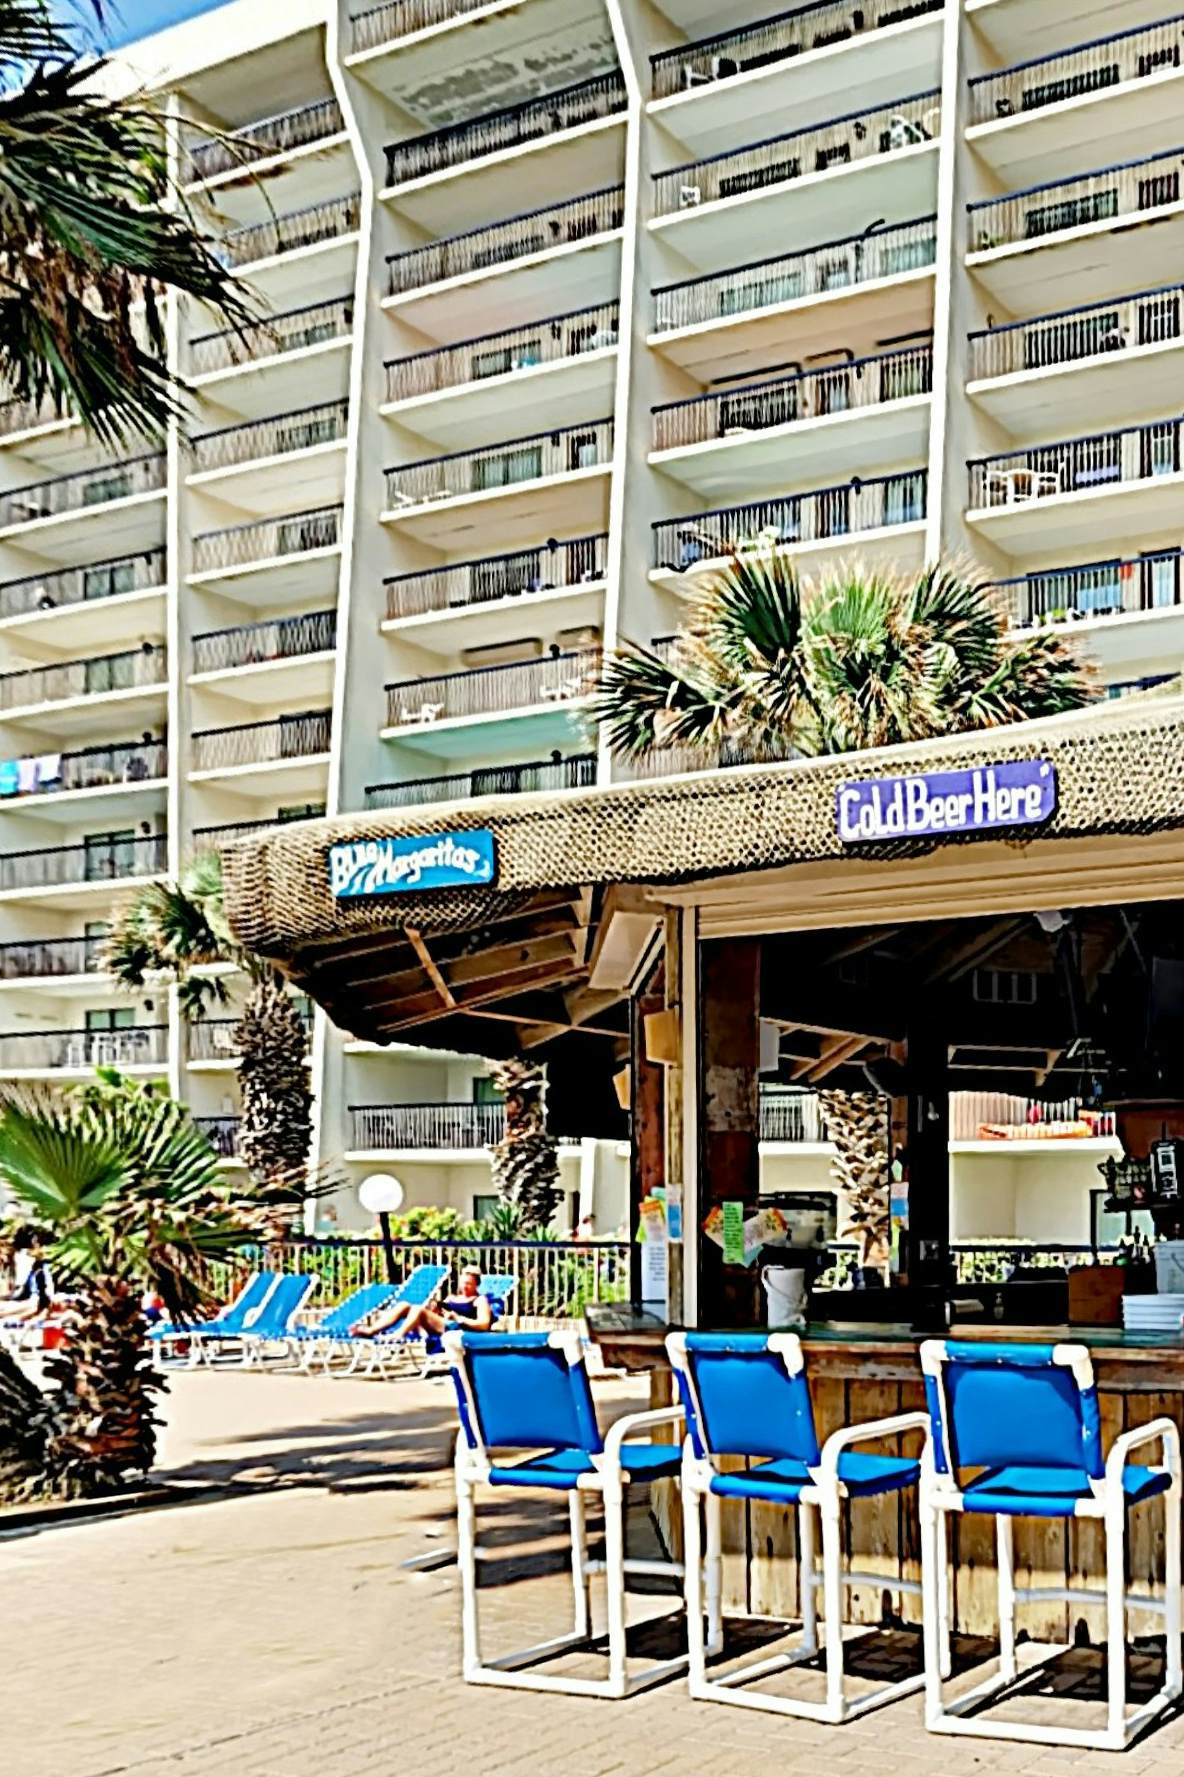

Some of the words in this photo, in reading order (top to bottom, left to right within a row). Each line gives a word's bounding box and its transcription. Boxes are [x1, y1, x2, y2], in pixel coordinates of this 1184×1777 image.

[840, 782, 905, 838] Cold
[905, 778, 973, 830] Beer
[972, 769, 1042, 823] Here
[330, 842, 377, 894] Blue
[364, 837, 481, 894] Margaritas
